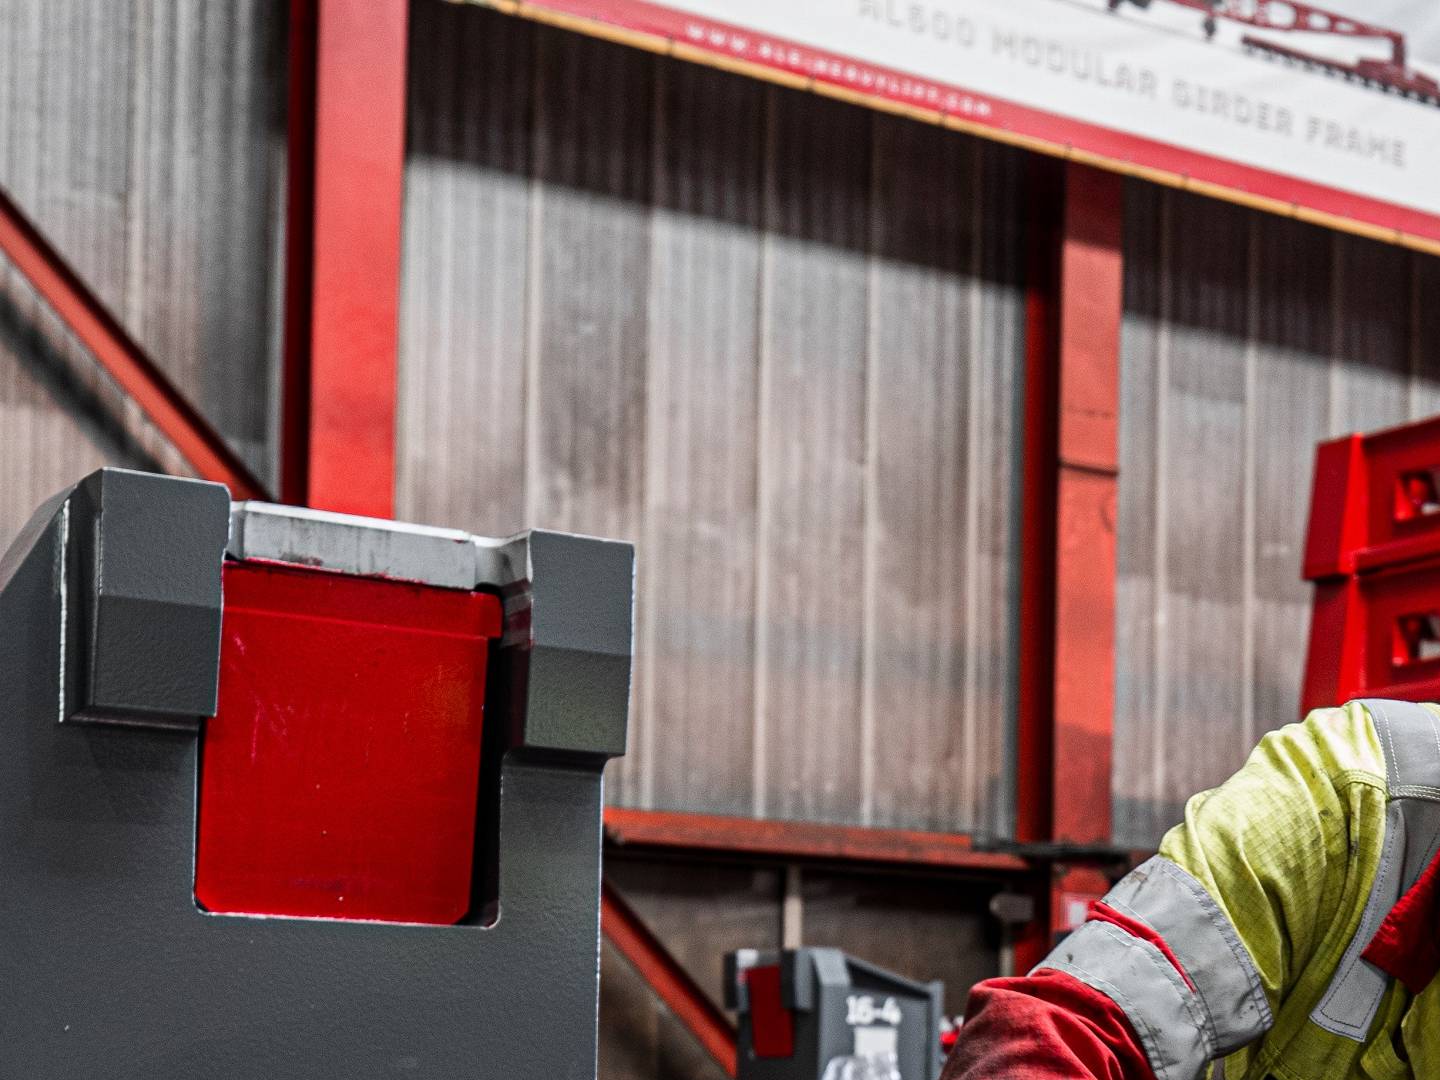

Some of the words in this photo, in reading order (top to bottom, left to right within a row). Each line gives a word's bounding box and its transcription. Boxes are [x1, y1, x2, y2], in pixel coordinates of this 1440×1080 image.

[991, 27, 1156, 100] MODULAR
[1172, 78, 1294, 137] GIRDER
[1306, 115, 1407, 168] FRAME
